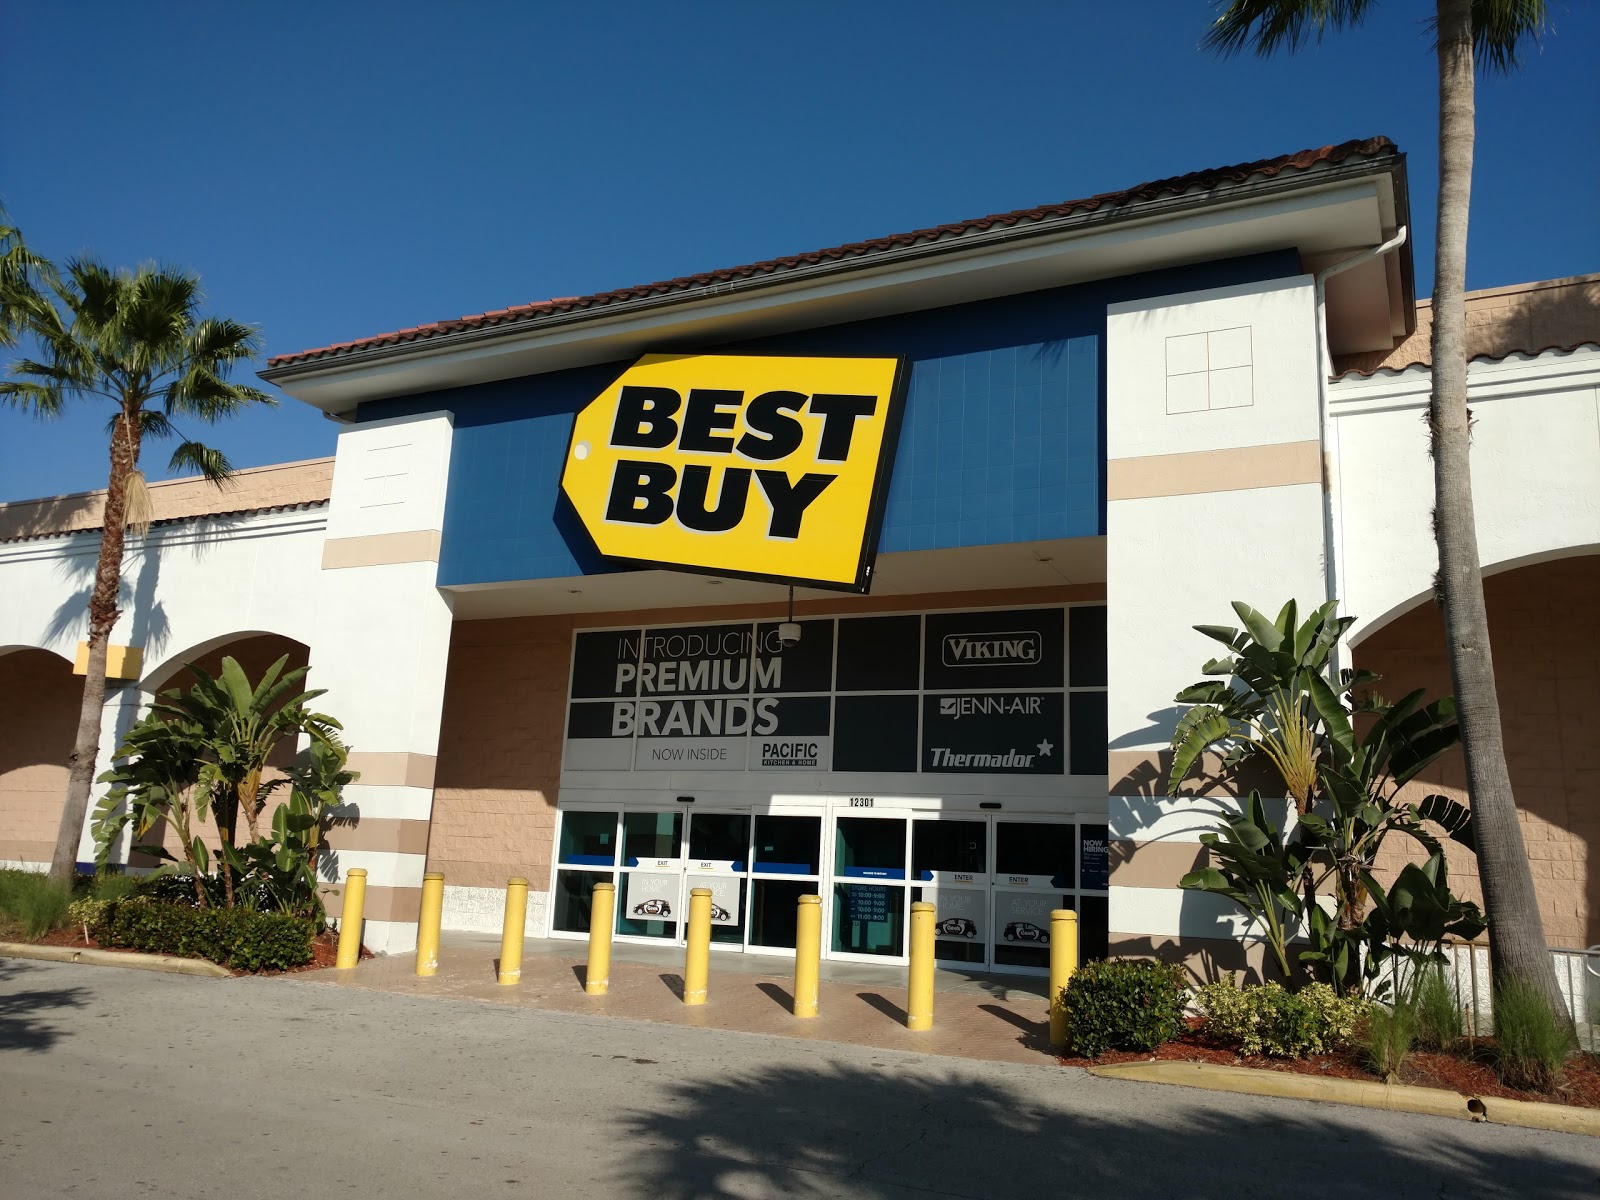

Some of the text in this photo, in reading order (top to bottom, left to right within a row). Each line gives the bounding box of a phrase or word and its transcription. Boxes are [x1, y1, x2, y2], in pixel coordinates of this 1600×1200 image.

[608, 385, 878, 462] BEST
[603, 459, 839, 541] BUY
[617, 630, 784, 660] INTRODUCING
[948, 638, 1036, 661] VIKING
[615, 656, 782, 693] PREMIUM
[611, 698, 780, 737] BRANDS
[954, 696, 1042, 720] JENN-AIR
[651, 748, 728, 761] NOW INSIDE
[762, 742, 818, 758] PACIFIC
[931, 748, 1036, 768] Thermador
[850, 797, 875, 808] 12301
[651, 879, 668, 887] YOUR
[1008, 876, 1029, 884] ENTER
[949, 895, 972, 904] YOUR
[1023, 899, 1047, 908] YOUR
